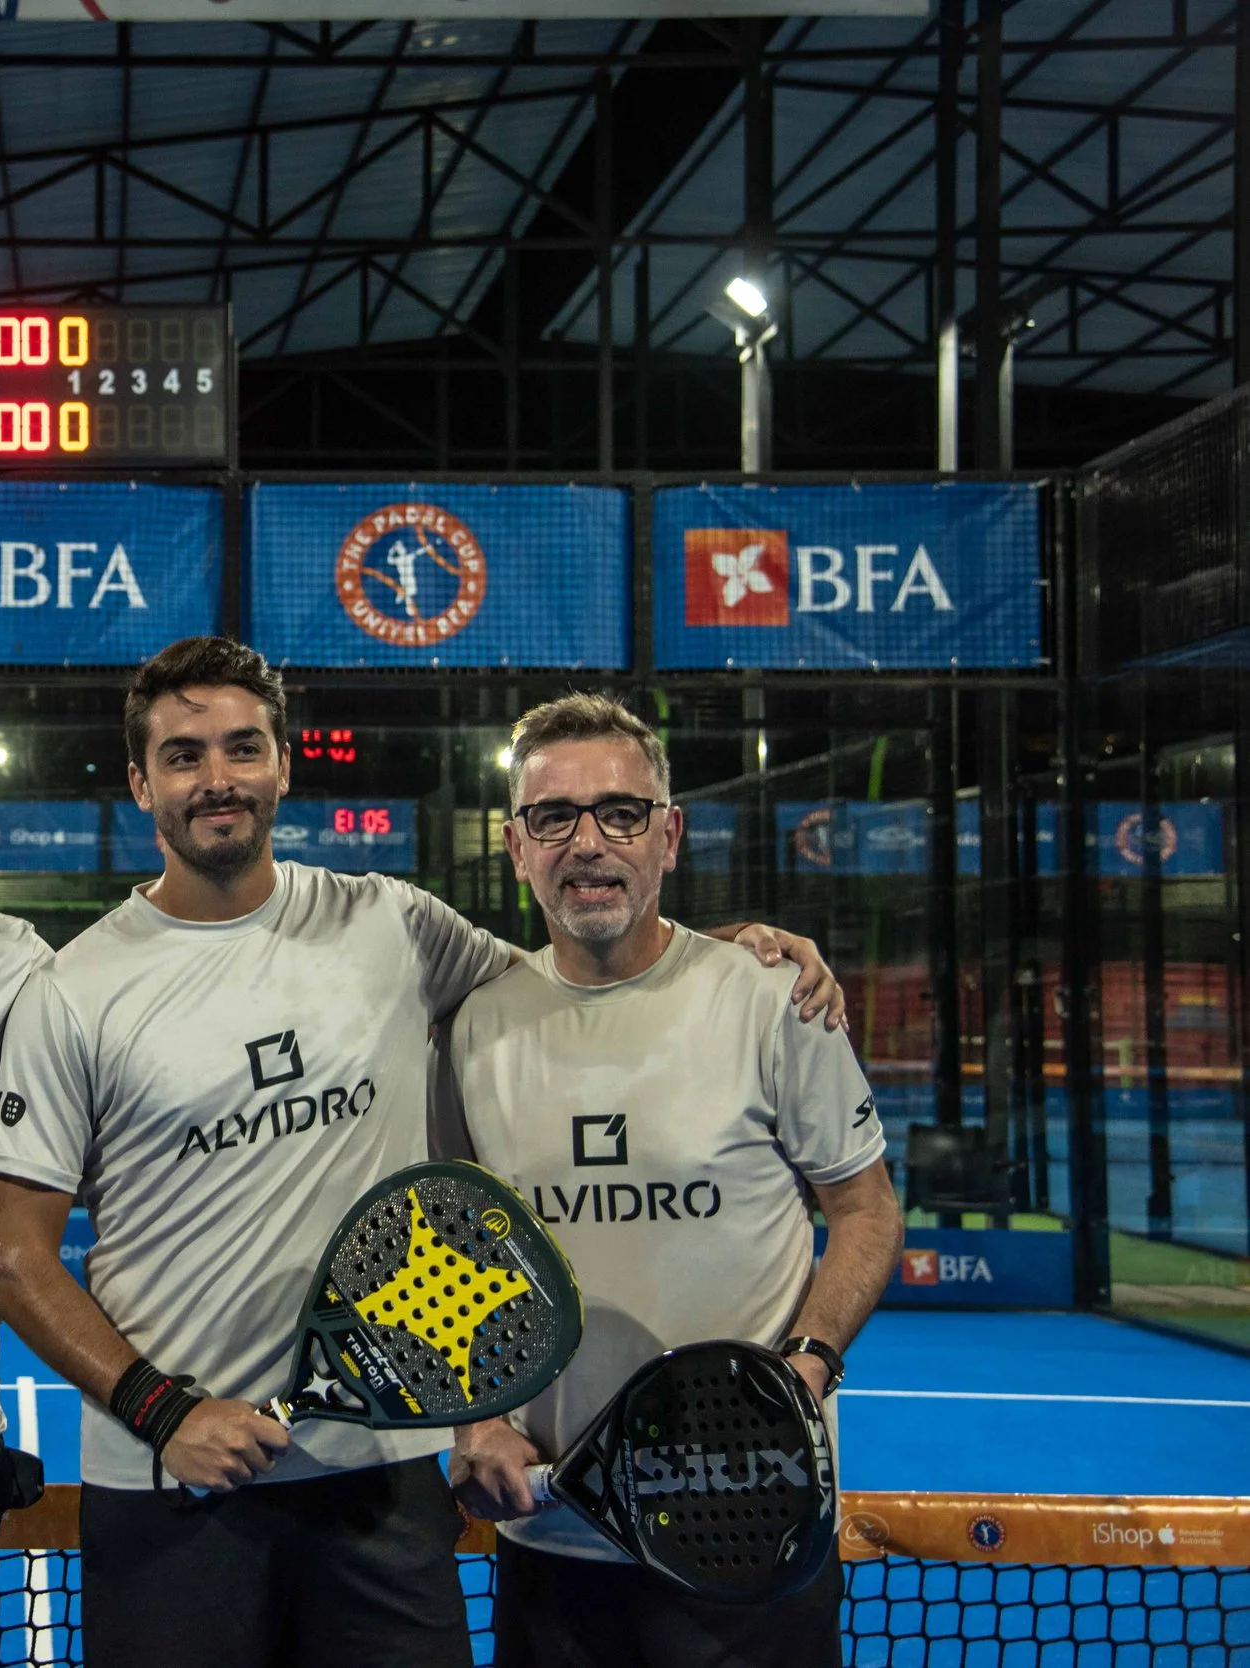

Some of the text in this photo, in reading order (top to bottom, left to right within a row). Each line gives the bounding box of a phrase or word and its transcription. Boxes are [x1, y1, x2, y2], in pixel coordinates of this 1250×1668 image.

[68, 369, 212, 395] 1 2 3 4 5
[342, 505, 479, 573] THE PADEL CUP
[0, 541, 149, 609] BFA
[796, 544, 954, 612] BFA
[352, 599, 427, 641] UNITEL
[177, 1078, 376, 1161] ALVIDRO
[531, 1180, 721, 1223] LVIDRO
[940, 1255, 993, 1283] BFA
[1092, 1521, 1154, 1550] iShop
